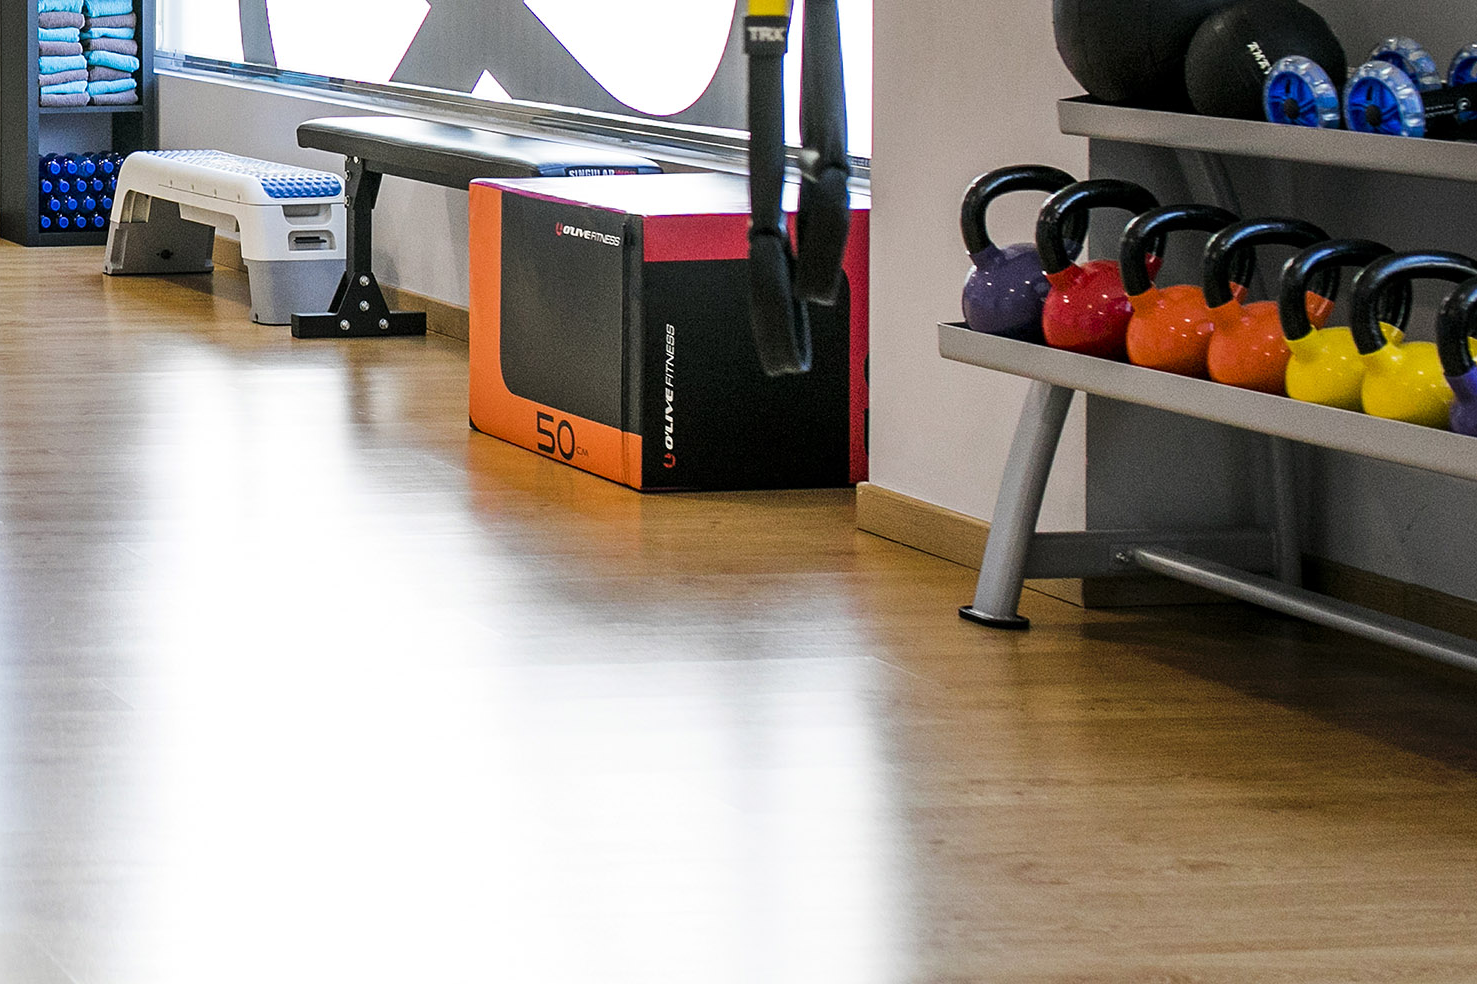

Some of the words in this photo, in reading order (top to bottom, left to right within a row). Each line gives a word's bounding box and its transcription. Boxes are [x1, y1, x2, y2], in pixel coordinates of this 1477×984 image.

[747, 26, 785, 42] TRX
[665, 323, 675, 388] FITNESS
[536, 410, 575, 461] 50
